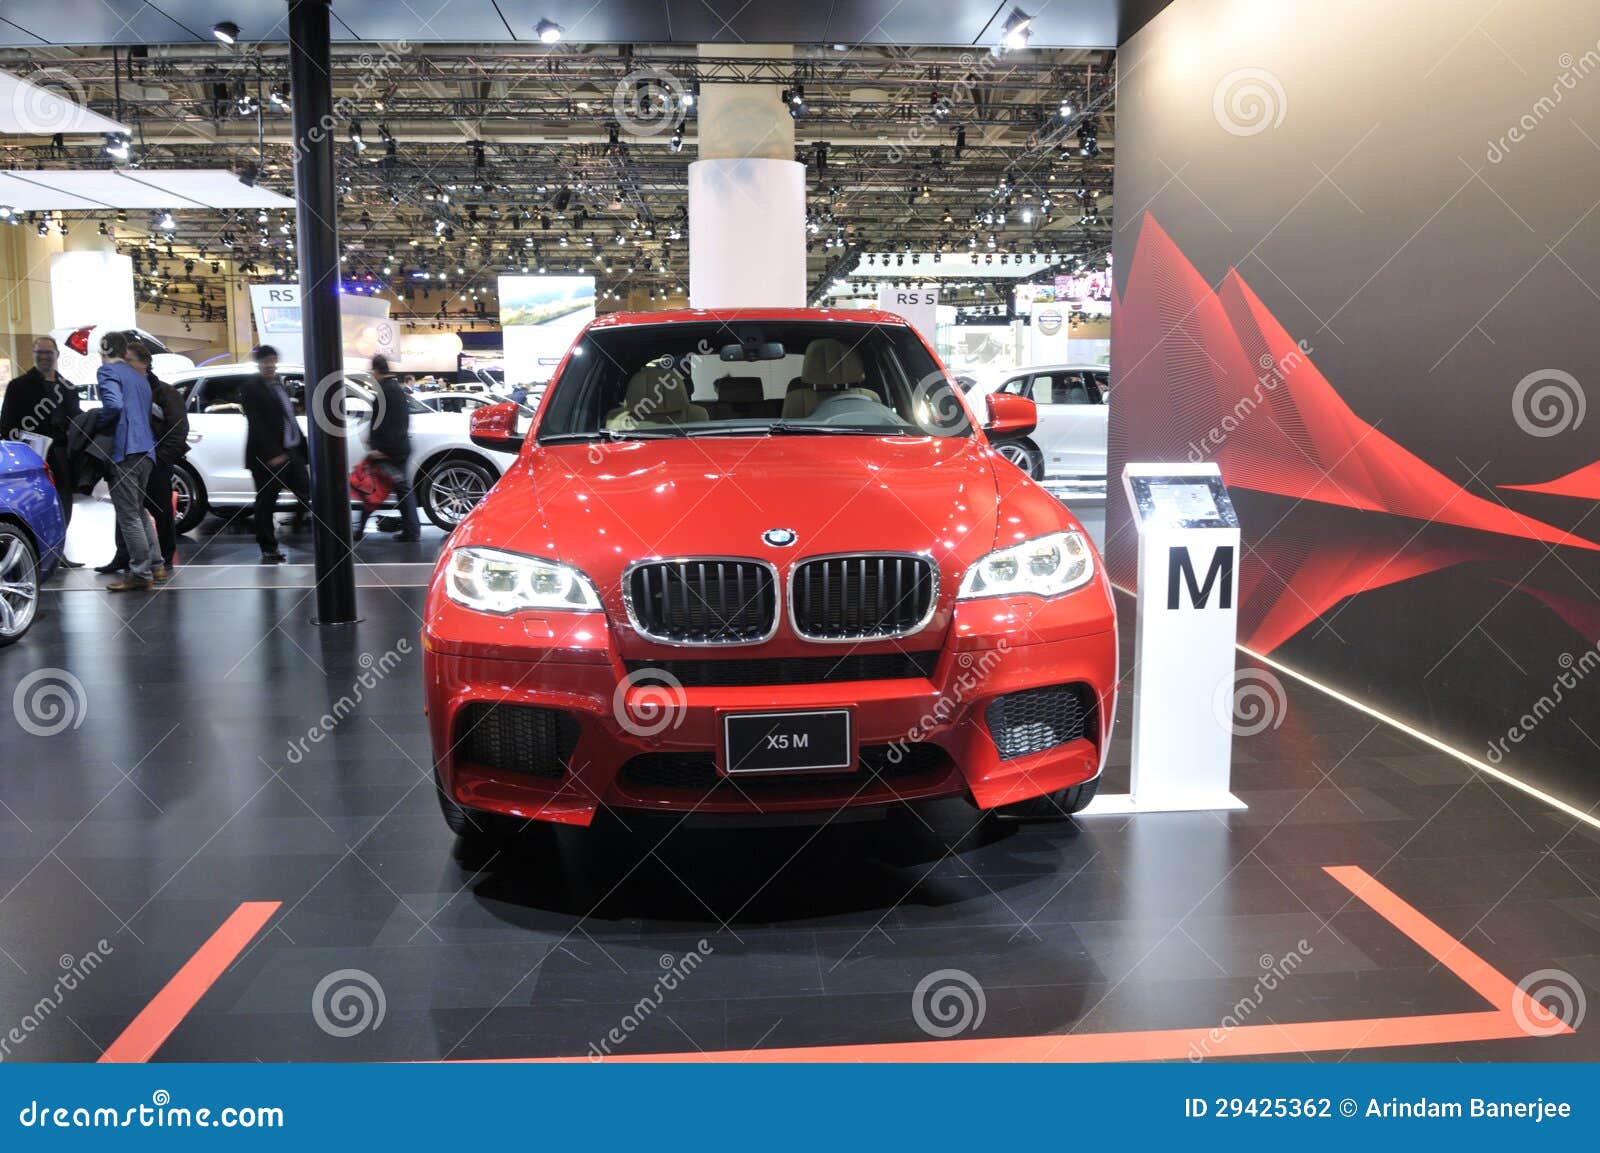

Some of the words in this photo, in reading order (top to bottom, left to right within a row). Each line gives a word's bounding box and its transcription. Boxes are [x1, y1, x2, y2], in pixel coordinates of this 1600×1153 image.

[268, 289, 294, 302] RS
[896, 293, 919, 305] RS
[924, 293, 935, 305] 5
[1167, 545, 1234, 610] M
[767, 734, 790, 750] X5
[792, 733, 809, 748] M
